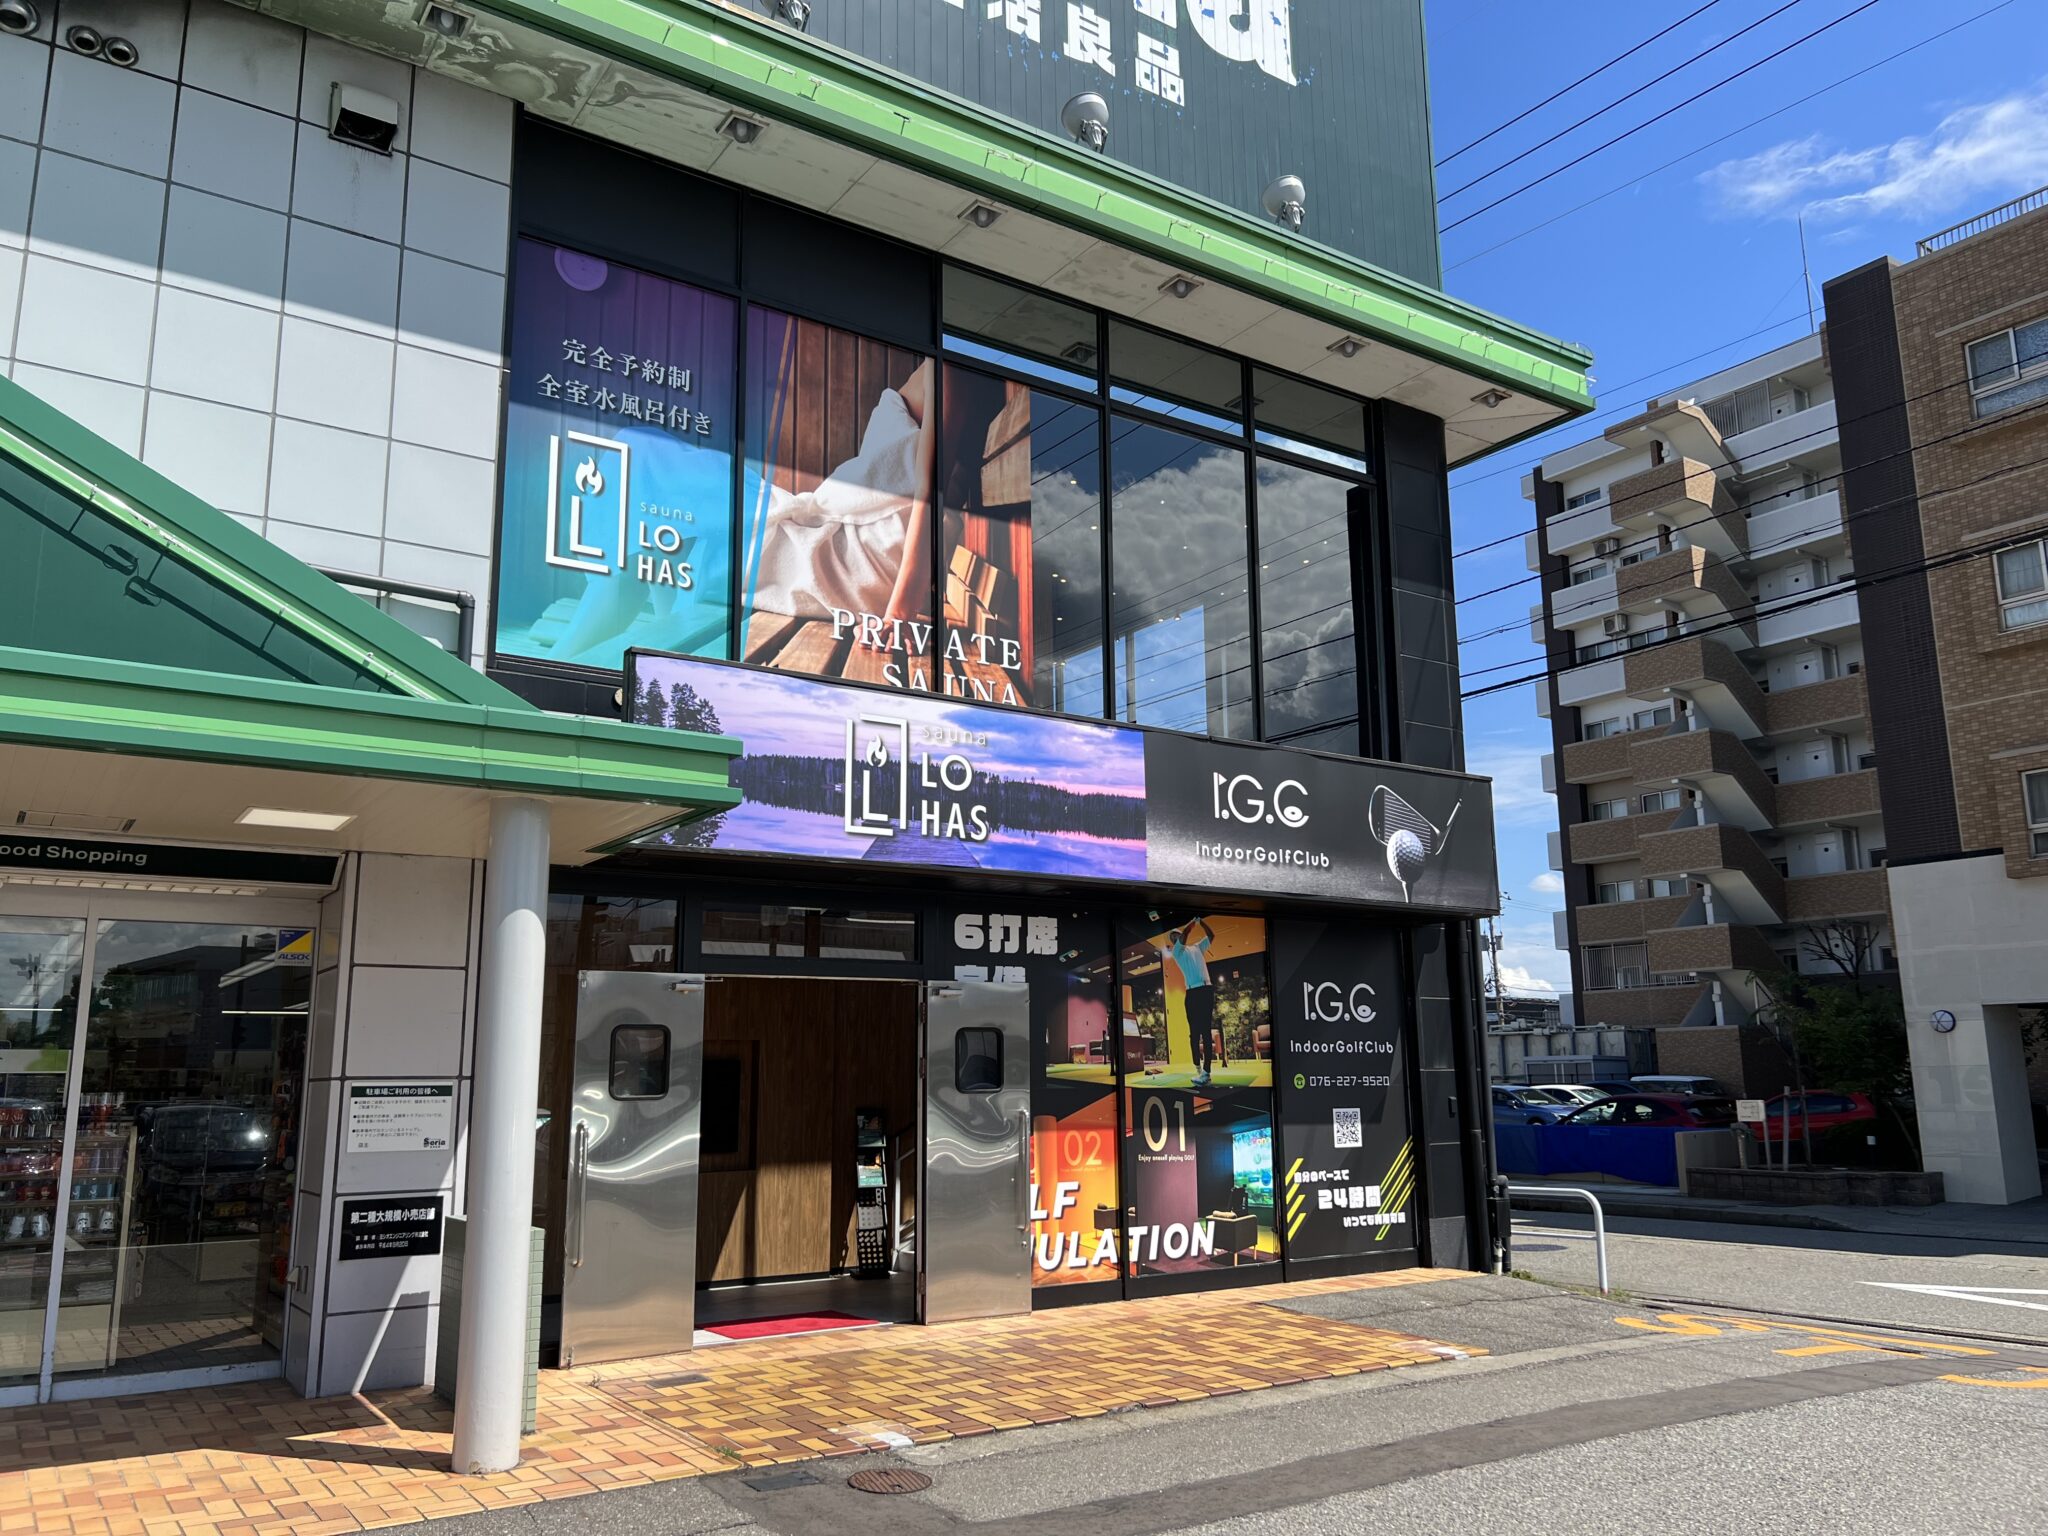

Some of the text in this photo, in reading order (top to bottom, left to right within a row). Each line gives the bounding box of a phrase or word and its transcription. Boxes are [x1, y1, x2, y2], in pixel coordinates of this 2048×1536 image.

[561, 338, 692, 393] 完全予約制
[537, 373, 712, 435] 全室水風呂付き
[640, 502, 694, 523] sauna
[639, 521, 682, 553] LO
[637, 557, 693, 590] HAS
[830, 607, 1022, 671] PRIVATE
[920, 725, 987, 747] sauna
[922, 752, 974, 791] LO
[922, 800, 989, 841] HAS
[46, 845, 148, 866] Shopping
[1196, 841, 1330, 868] IndoorGolfClub
[1290, 1039, 1394, 1054] IndoorGolfClub
[1309, 1075, 1390, 1087] 076-227-9520
[1143, 1095, 1187, 1152] 01
[1063, 1130, 1102, 1167] 02
[351, 1207, 436, 1225] 第二種大規模小売店舗
[1031, 1221, 1216, 1271] ULATION
